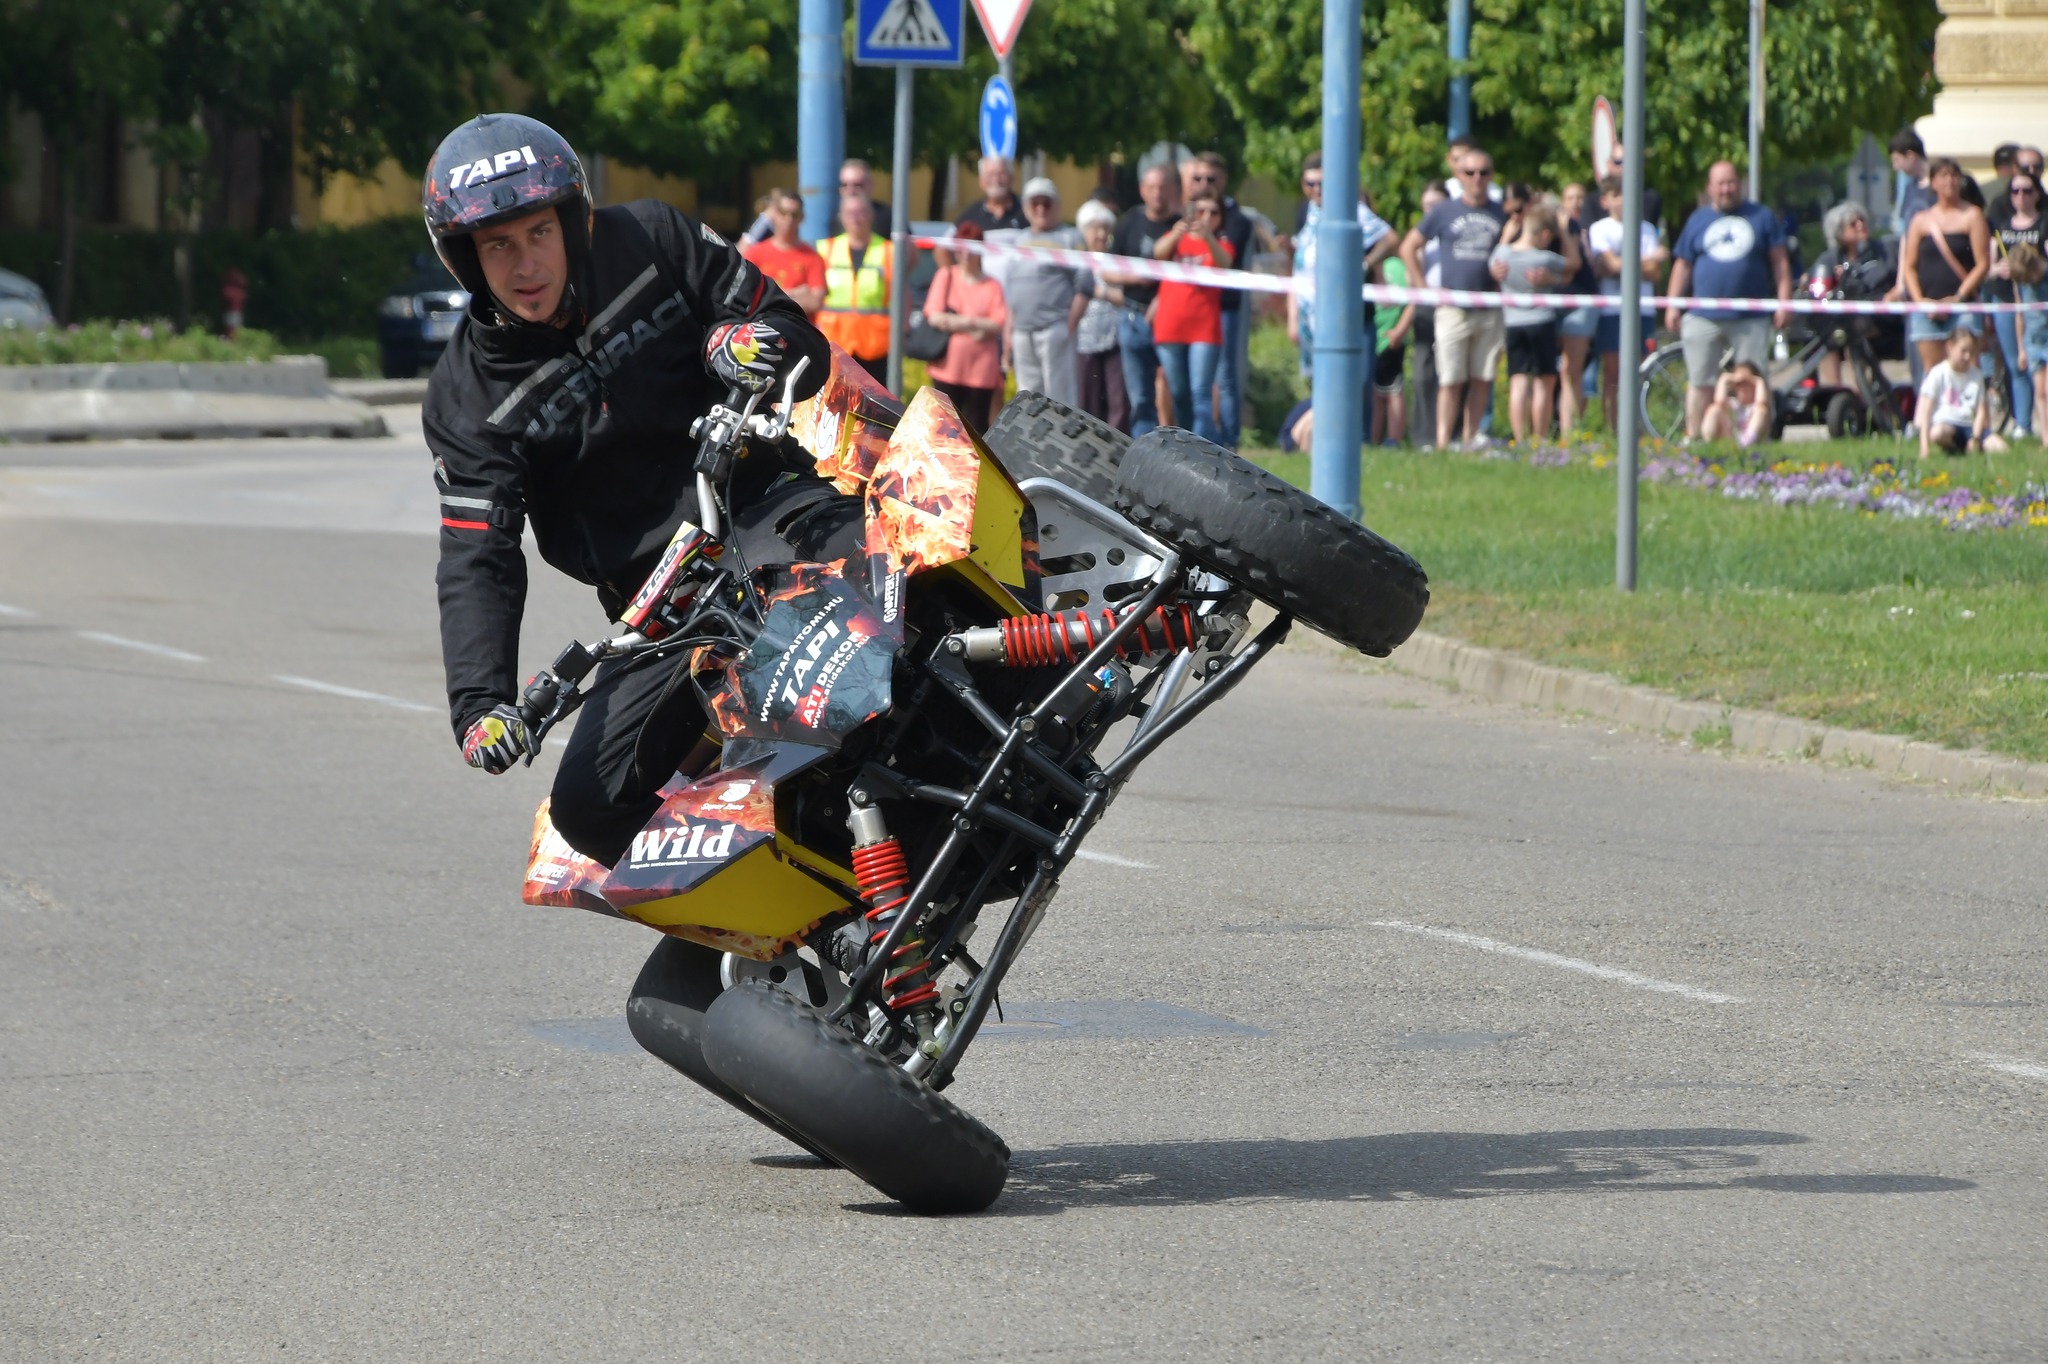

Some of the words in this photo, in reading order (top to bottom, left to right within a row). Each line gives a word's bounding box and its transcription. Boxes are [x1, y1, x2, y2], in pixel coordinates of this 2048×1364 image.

[448, 145, 538, 190] TAPI
[637, 544, 680, 602] TAG
[781, 619, 840, 706] TAPI
[803, 688, 822, 724] ATI
[816, 630, 864, 687] DEKOR
[812, 635, 870, 729] www.atidekor.hu
[630, 823, 737, 863] Wild
